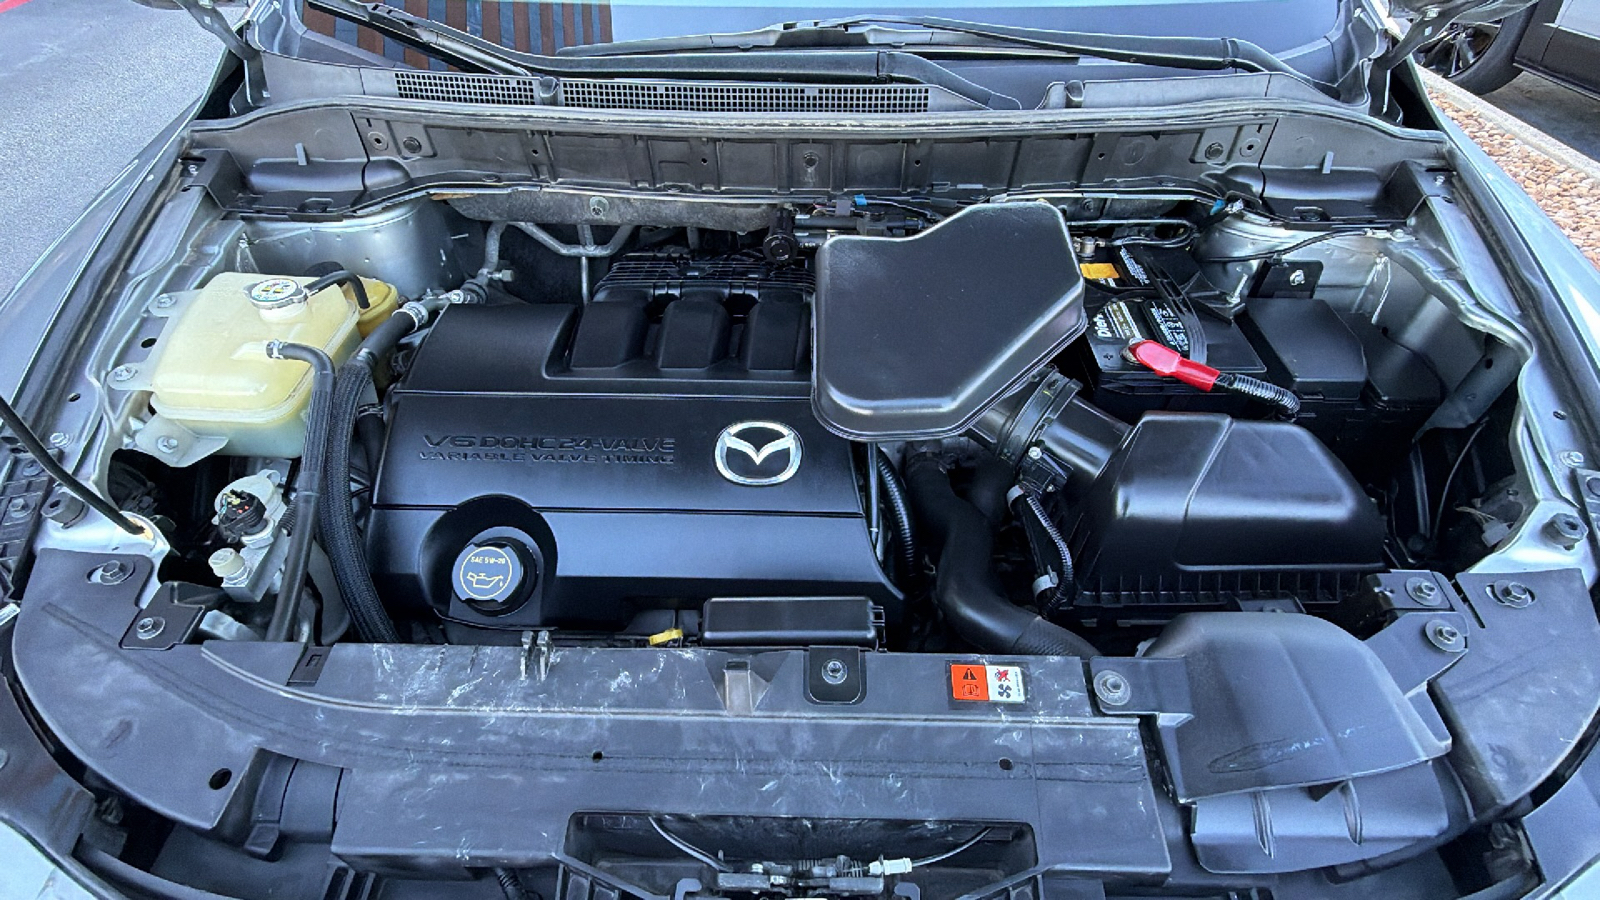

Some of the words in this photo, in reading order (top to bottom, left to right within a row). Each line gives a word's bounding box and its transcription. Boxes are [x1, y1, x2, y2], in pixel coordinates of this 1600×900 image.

[423, 434, 477, 448] V6
[478, 435, 555, 451] DOHC
[419, 451, 526, 462] VARIABLE
[530, 453, 597, 463] VALVE
[601, 454, 674, 464] TIMING
[470, 556, 484, 564] SAE
